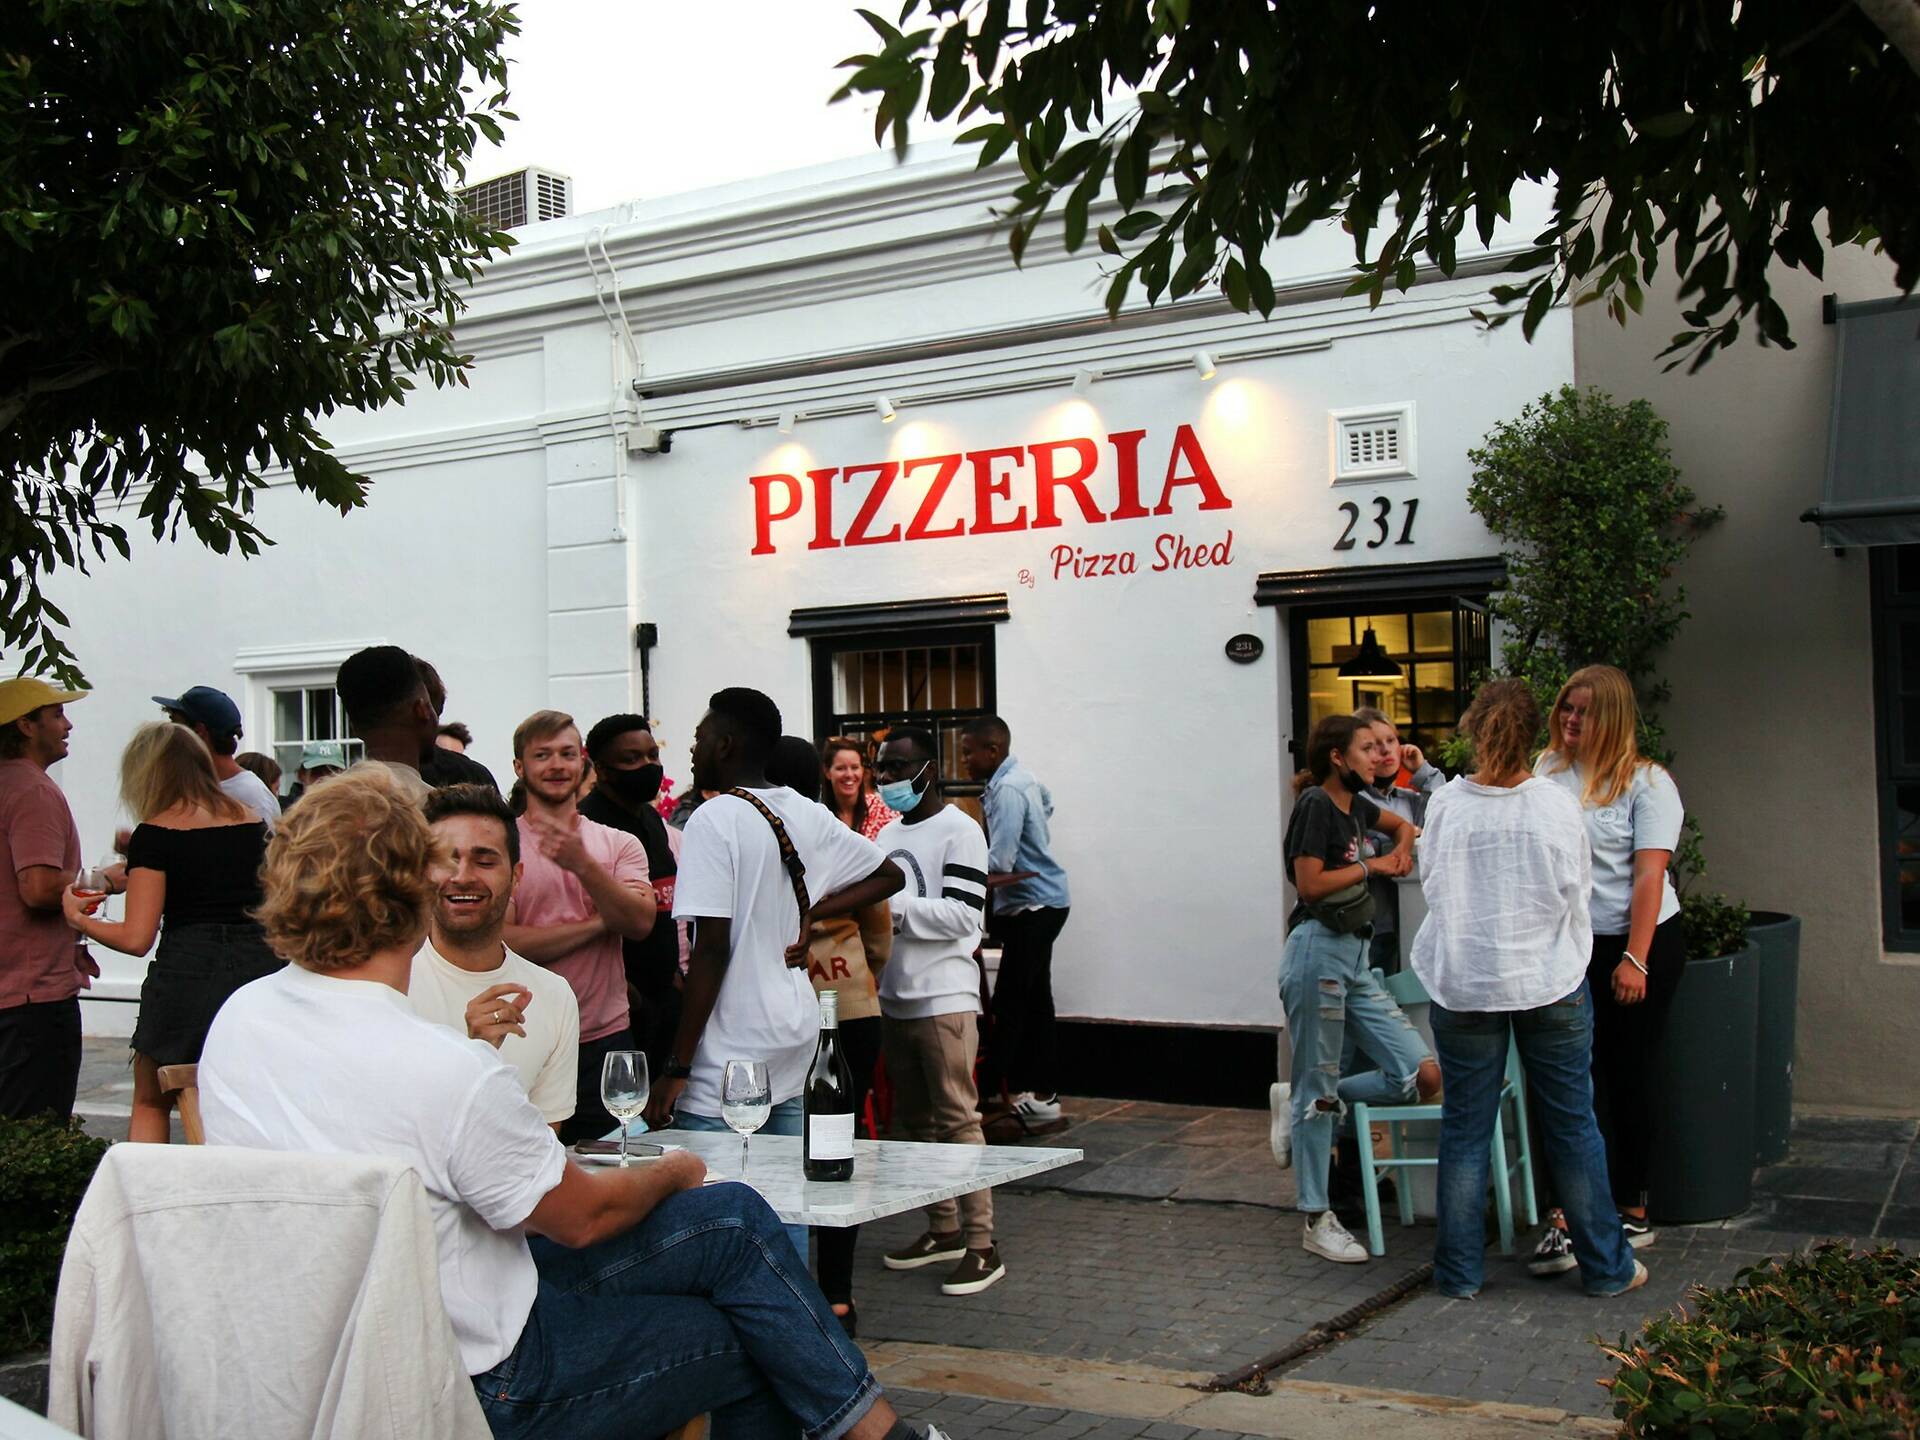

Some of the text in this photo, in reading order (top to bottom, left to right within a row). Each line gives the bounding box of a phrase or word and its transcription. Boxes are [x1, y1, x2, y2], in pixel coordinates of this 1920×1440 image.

[749, 423, 1233, 556] PIZZERIA
[1333, 496, 1419, 550] 231
[1017, 529, 1235, 588] By Pizza Shed
[1235, 641, 1252, 650] 231
